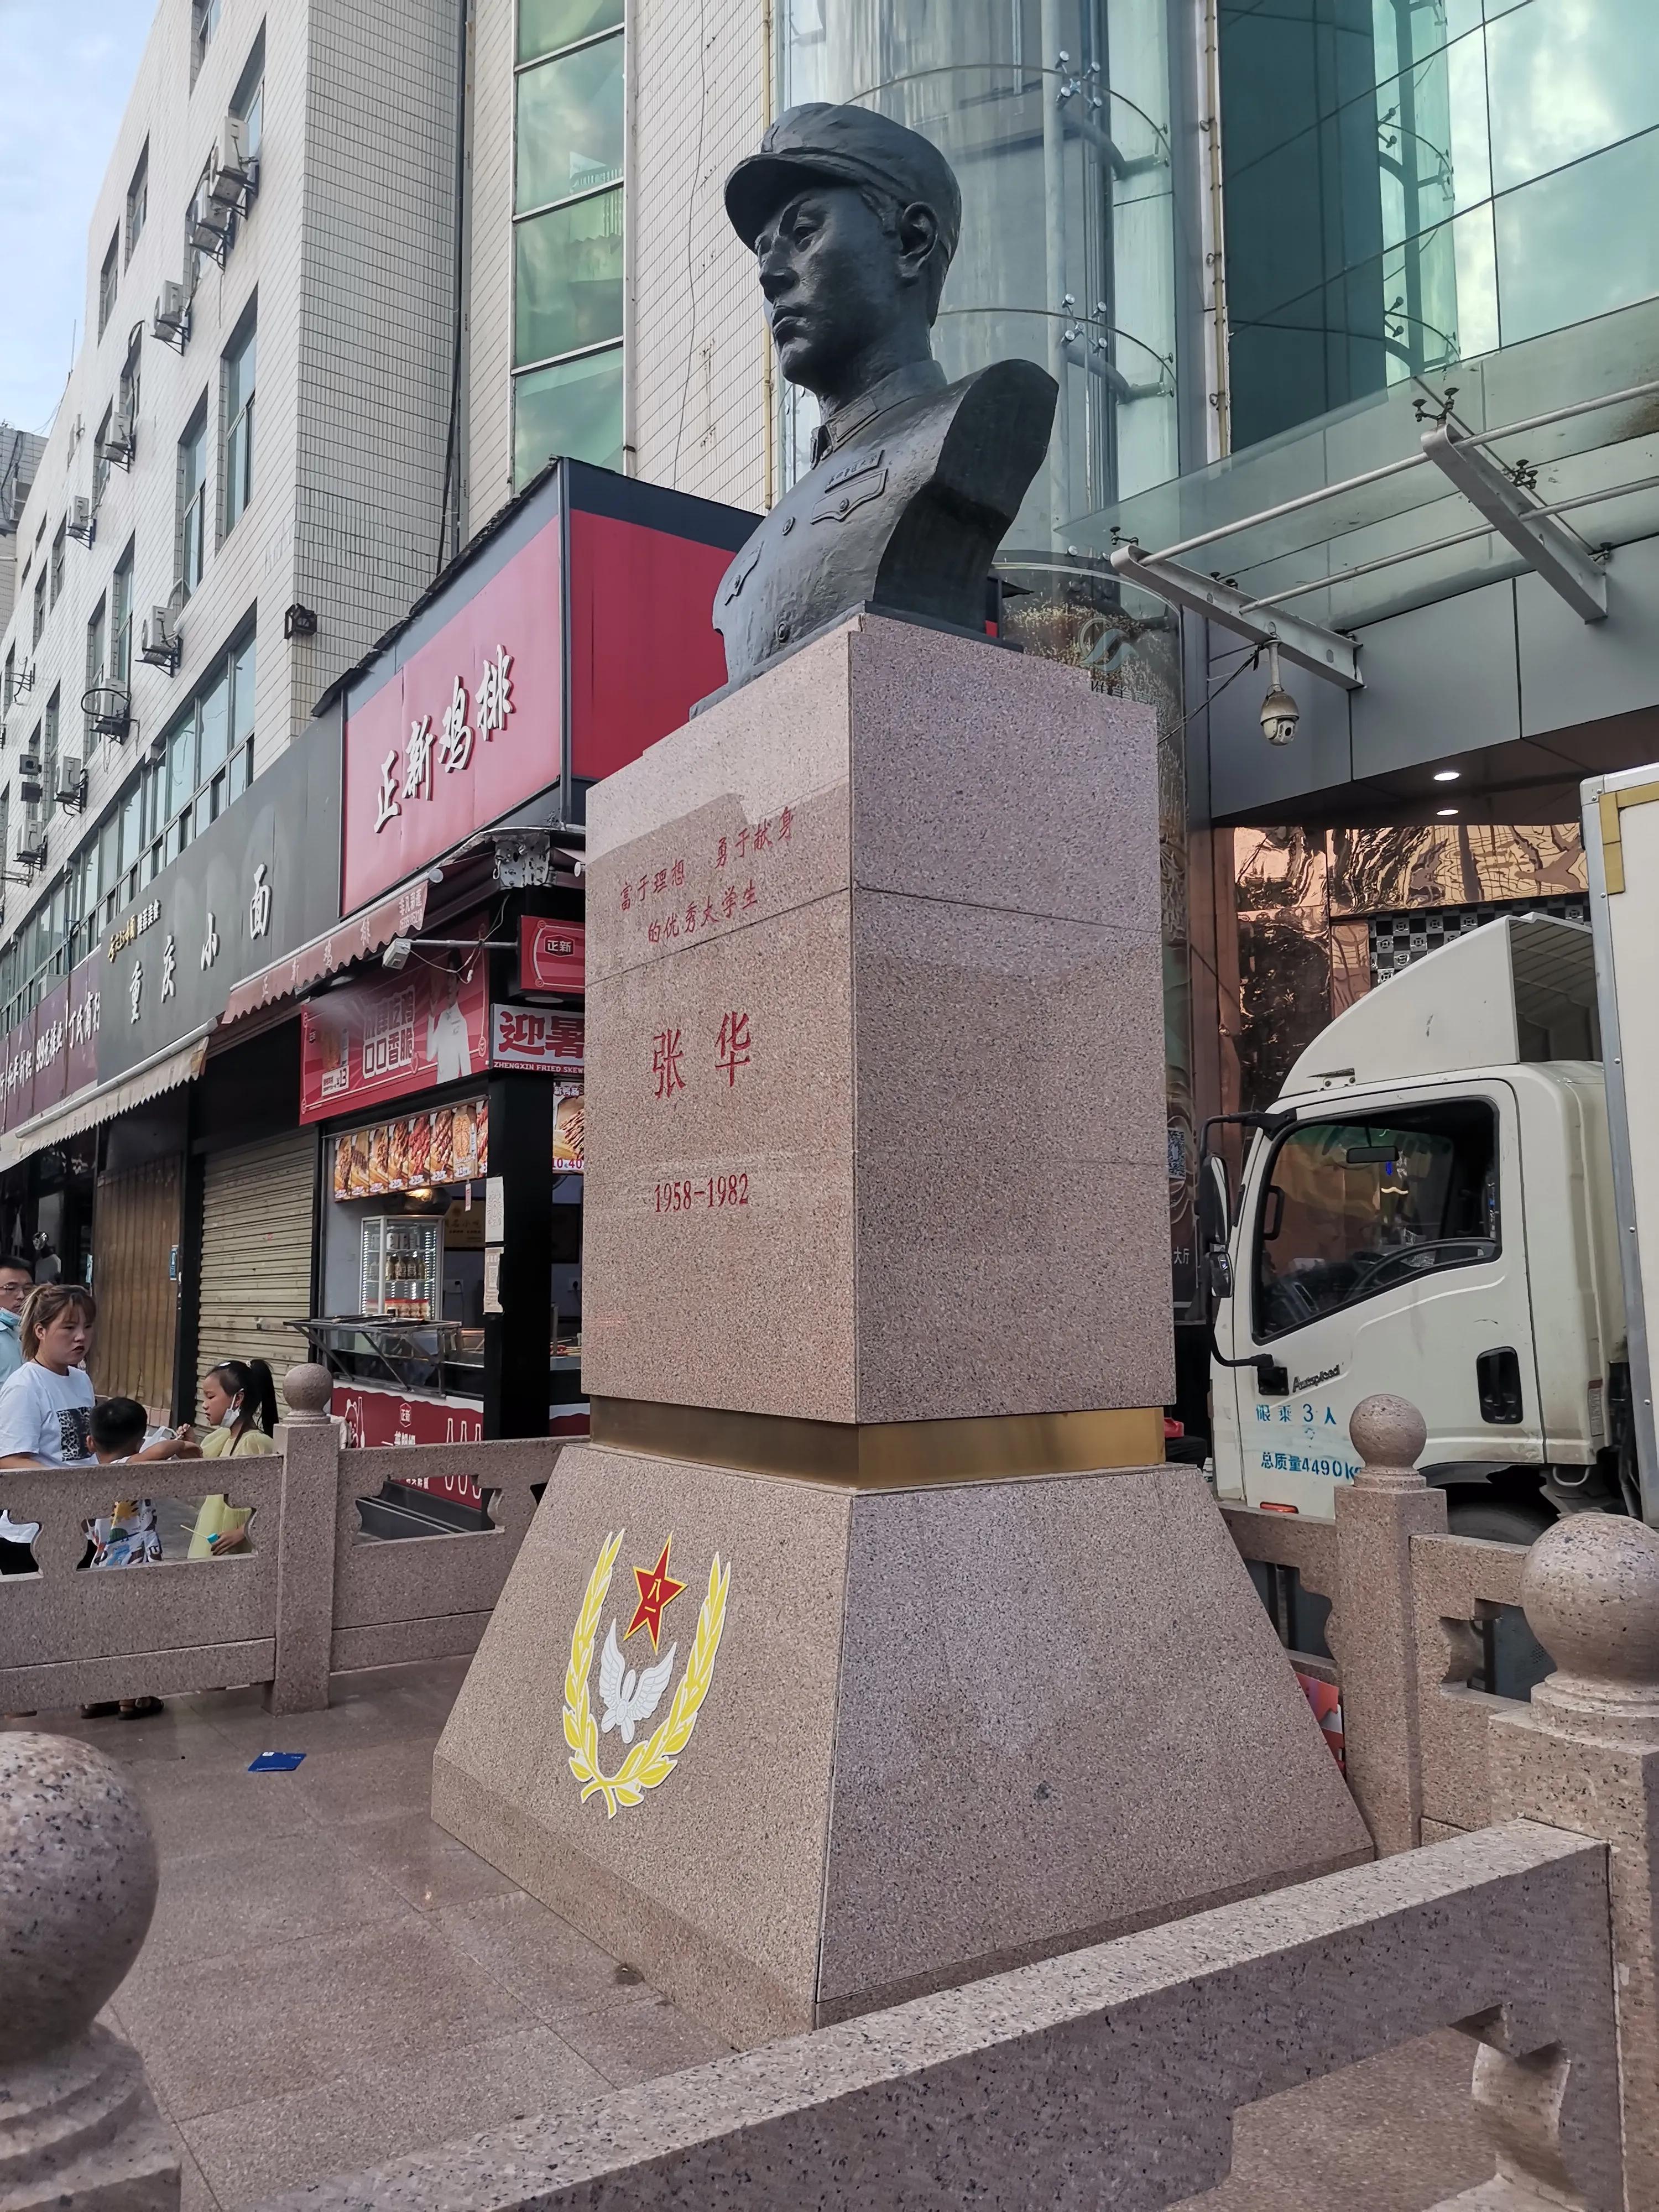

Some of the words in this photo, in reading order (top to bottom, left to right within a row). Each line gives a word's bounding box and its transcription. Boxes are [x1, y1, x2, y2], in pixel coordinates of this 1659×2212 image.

[374, 644, 513, 833] 正新鸡排
[620, 859, 686, 911] 富于理想
[714, 806, 794, 869] 勇于献身
[648, 880, 759, 945] 的优秀大学生
[129, 863, 272, 1025] 重庆小面
[547, 940, 571, 953] 正新
[363, 1026, 413, 1074] 口口香脆
[493, 1061, 534, 1071] ZHENGXIN
[652, 1011, 753, 1100] 张华
[654, 1175, 749, 1213] 1958-1982
[1173, 1246, 1190, 1265] 大厅
[1256, 1404, 1337, 1425] 限乘3人
[644, 1577, 662, 1613] 八一
